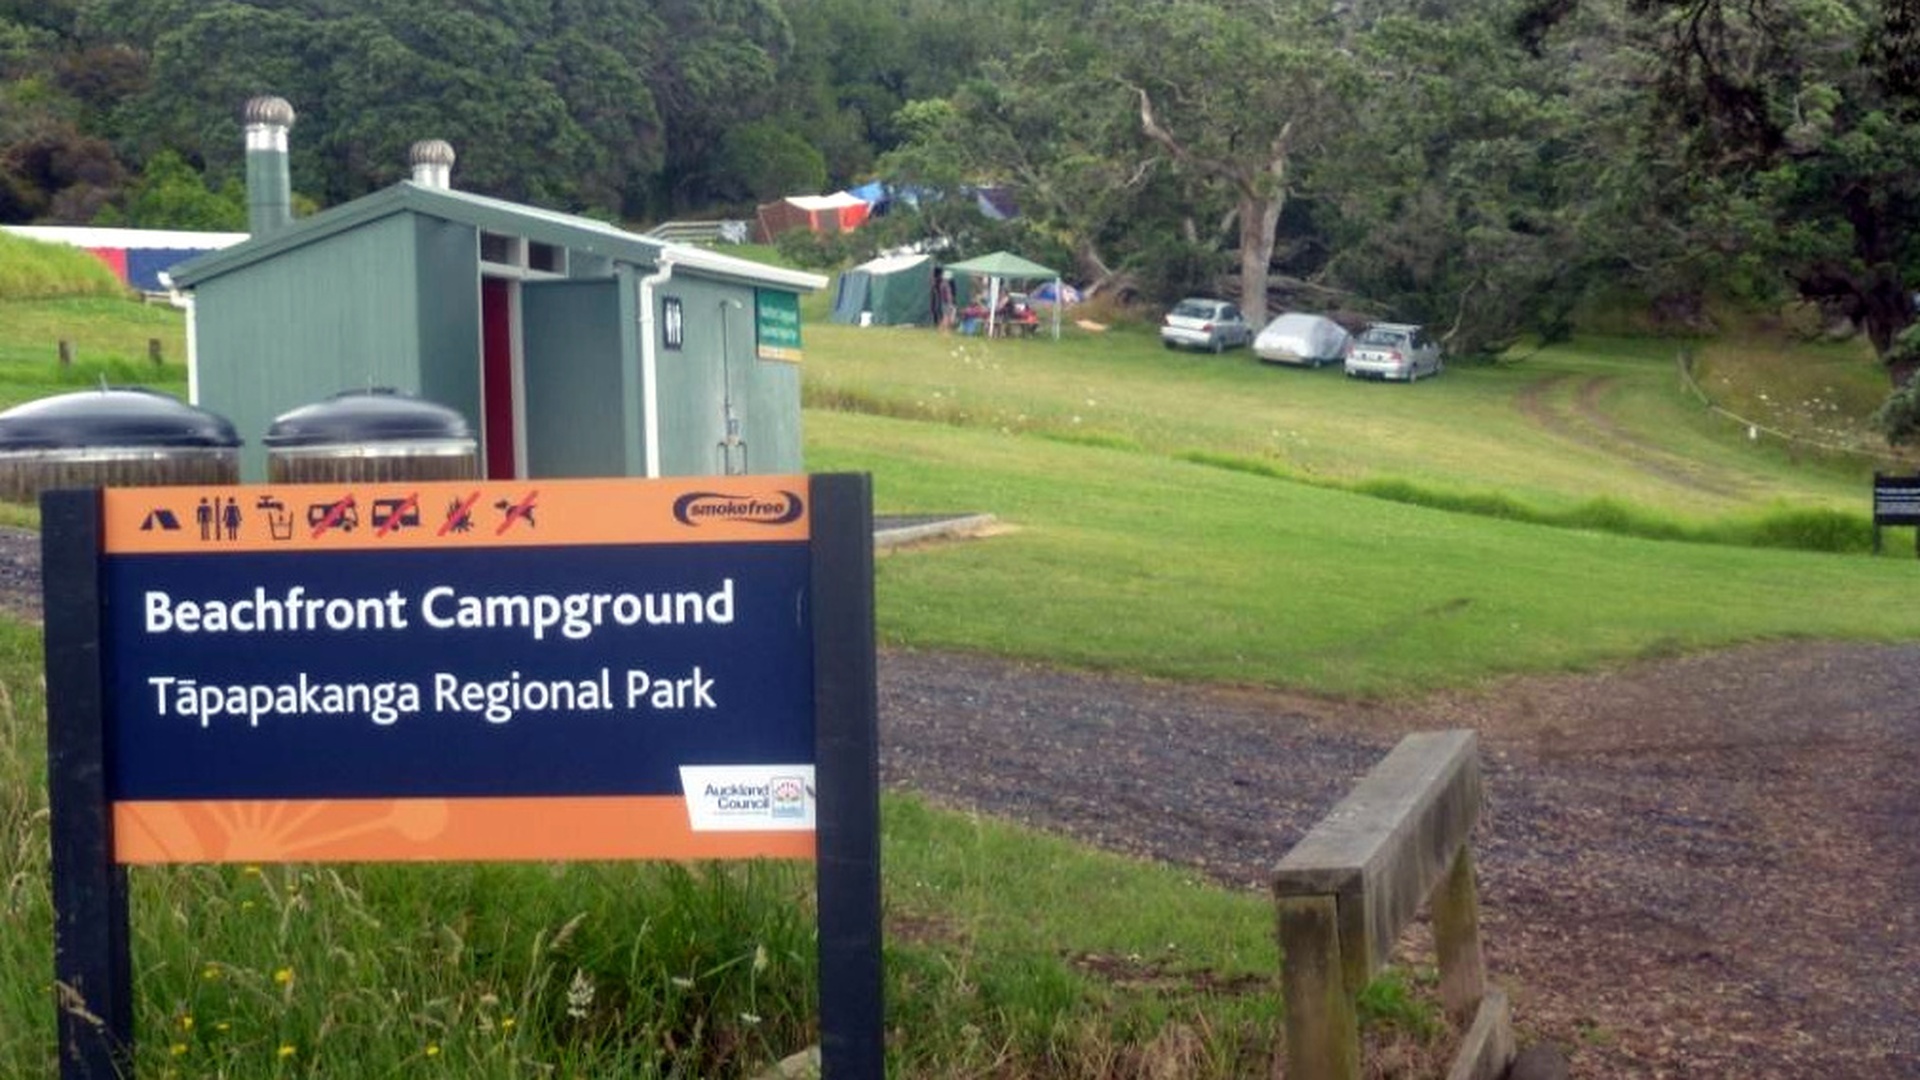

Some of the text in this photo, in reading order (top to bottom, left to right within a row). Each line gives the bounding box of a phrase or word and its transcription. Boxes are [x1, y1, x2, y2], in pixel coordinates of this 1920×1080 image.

[690, 500, 785, 517] smokefree
[144, 578, 735, 641] Beachfront Campground
[148, 666, 717, 728] Tāpapakanga Regional Park
[704, 783, 769, 797] Auckland
[718, 797, 770, 810] Council
